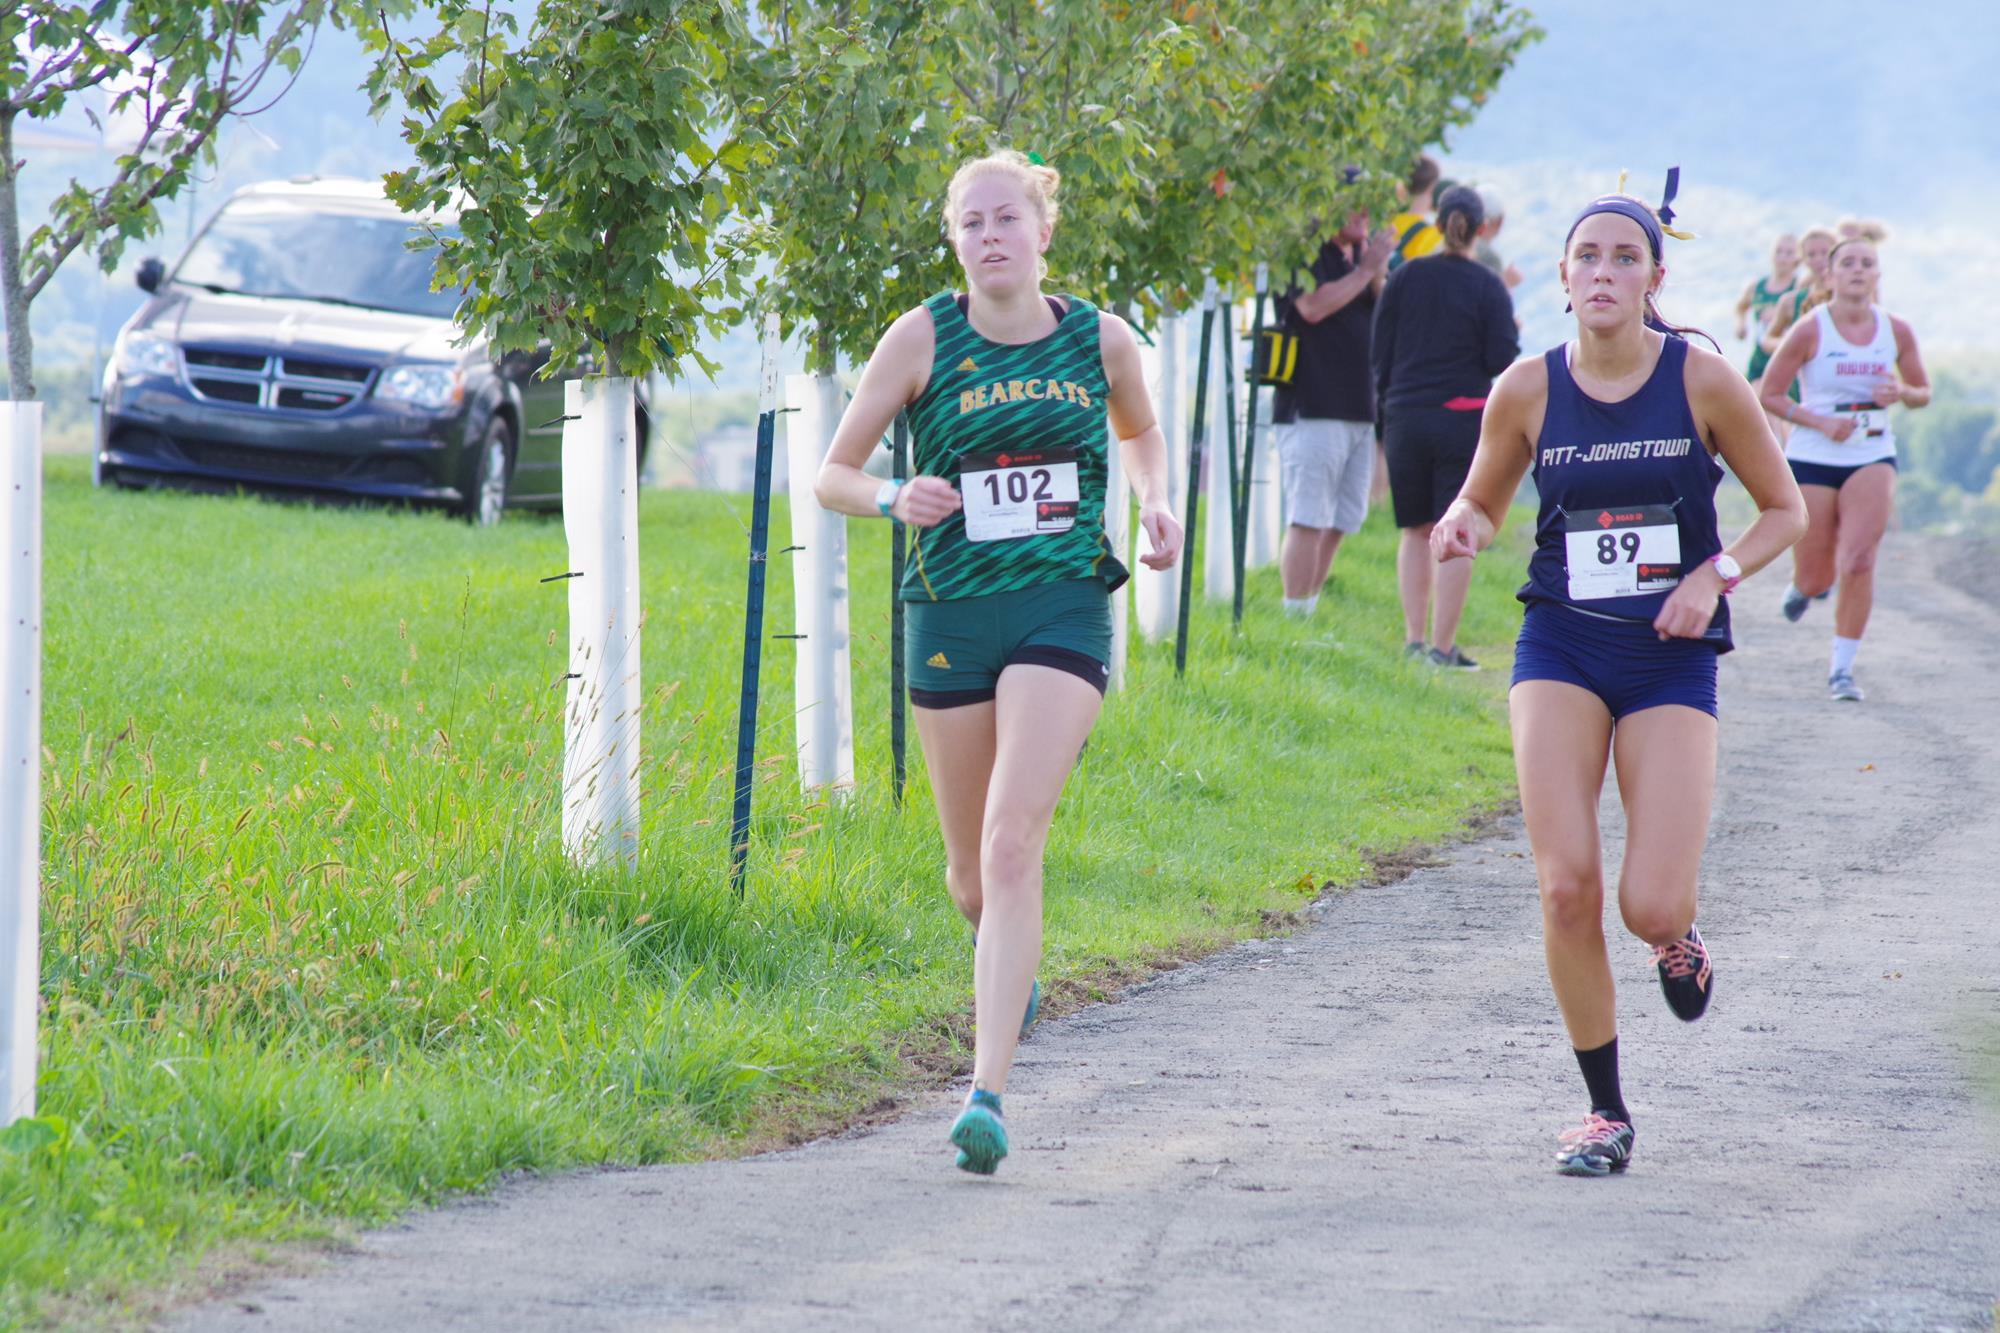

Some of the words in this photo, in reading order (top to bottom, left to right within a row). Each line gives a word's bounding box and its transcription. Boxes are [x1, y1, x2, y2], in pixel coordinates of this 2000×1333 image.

[959, 379, 1091, 414] BEARCATS
[1542, 438, 1691, 467] PITT-JOHNSTOWN
[984, 468, 1053, 505] 102
[1597, 532, 1641, 565] 89
